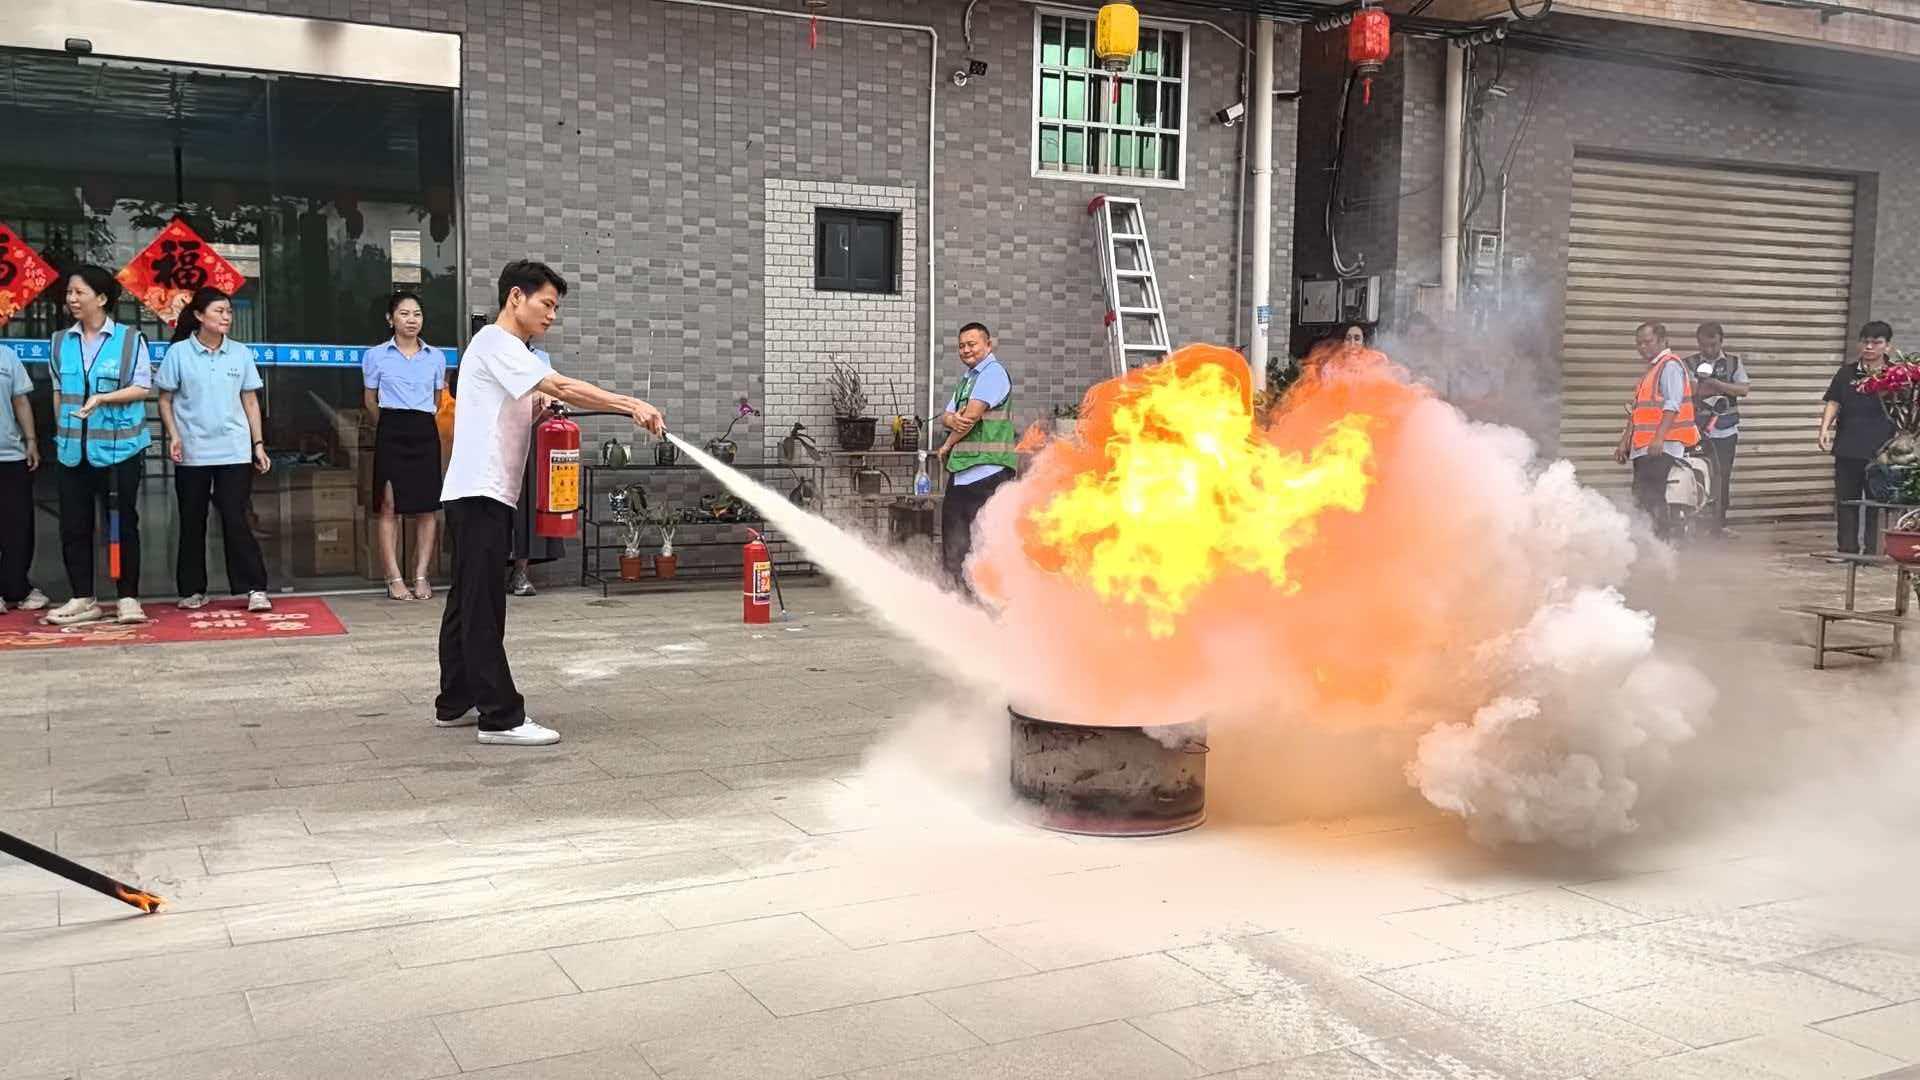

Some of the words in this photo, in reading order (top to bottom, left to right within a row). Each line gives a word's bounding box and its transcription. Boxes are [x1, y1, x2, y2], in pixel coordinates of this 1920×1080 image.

[151, 239, 208, 291] 福
[289, 348, 359, 362] 海南省质量
